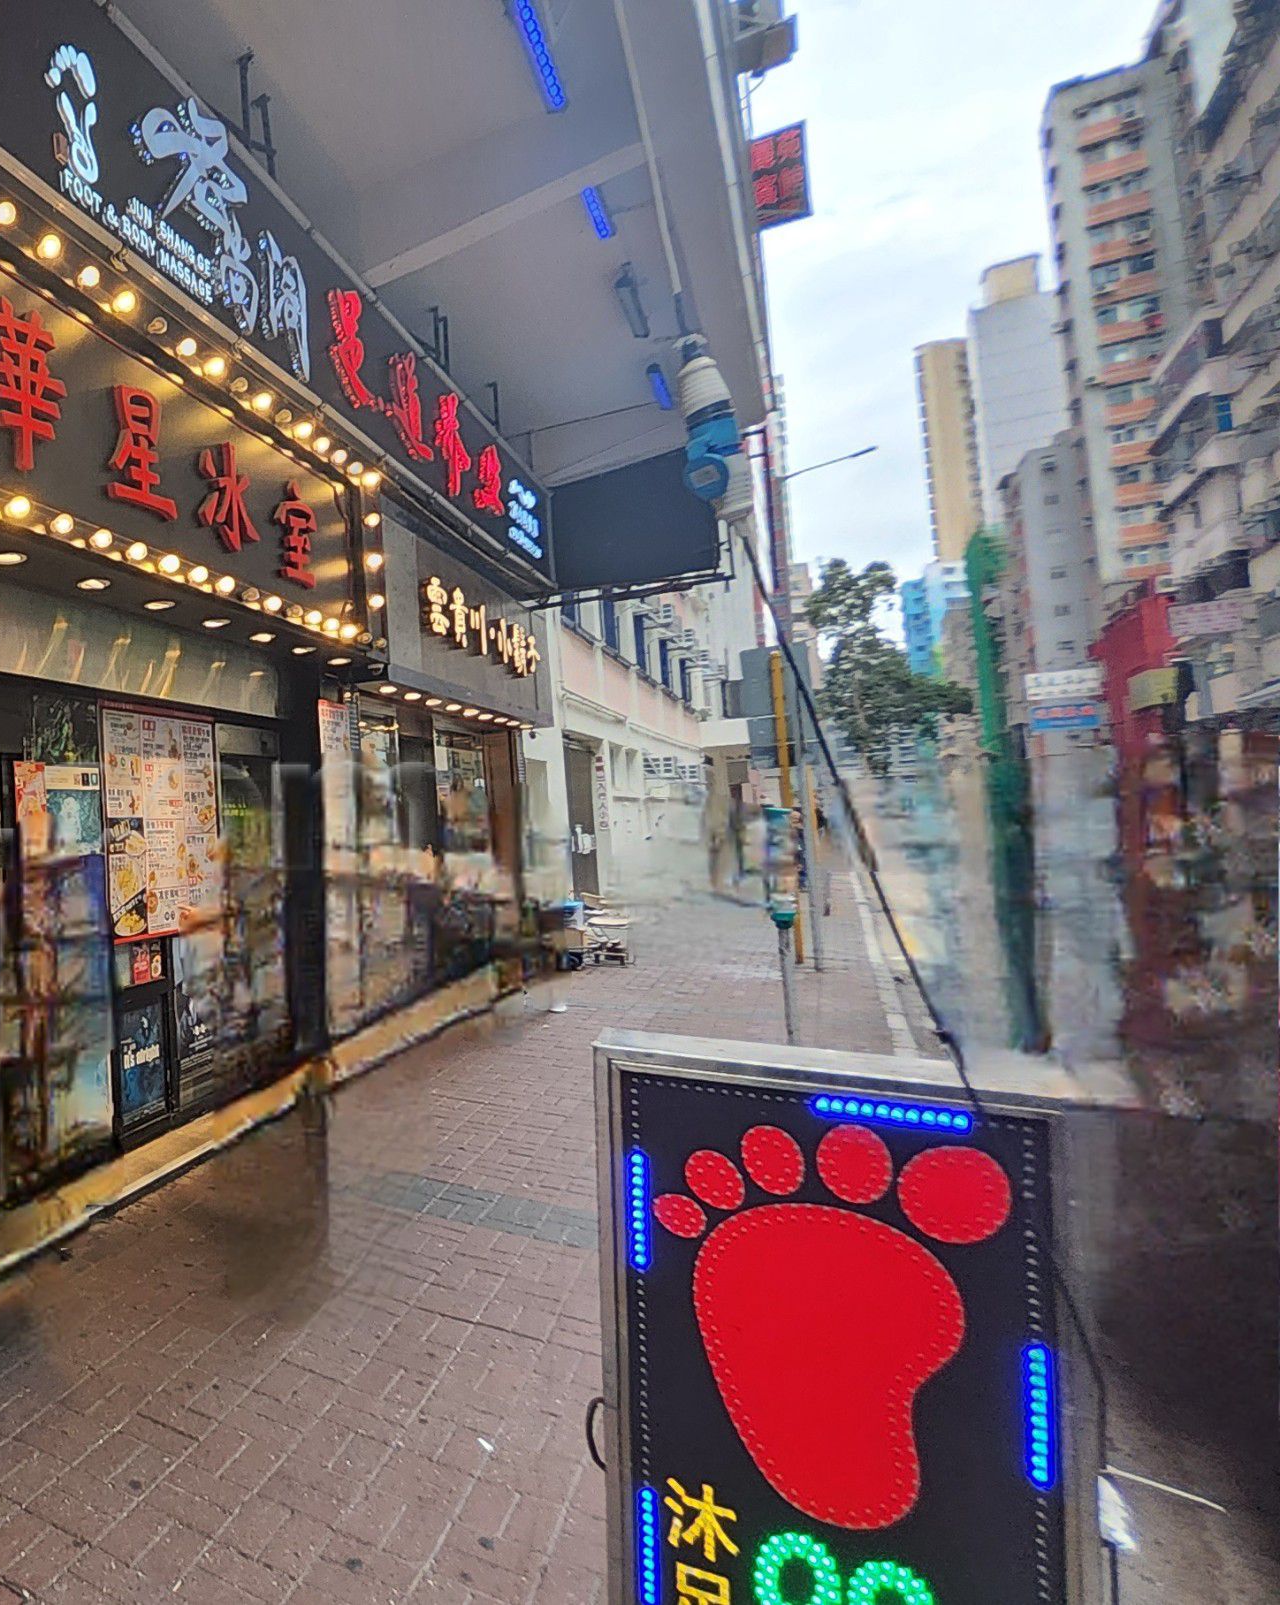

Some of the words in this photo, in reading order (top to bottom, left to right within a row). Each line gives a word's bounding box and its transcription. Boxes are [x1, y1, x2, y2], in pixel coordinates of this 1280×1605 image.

[60, 168, 103, 217] FOOT
[120, 214, 157, 259] BODY
[157, 248, 214, 304] MASSAGE
[127, 197, 154, 230] JUN
